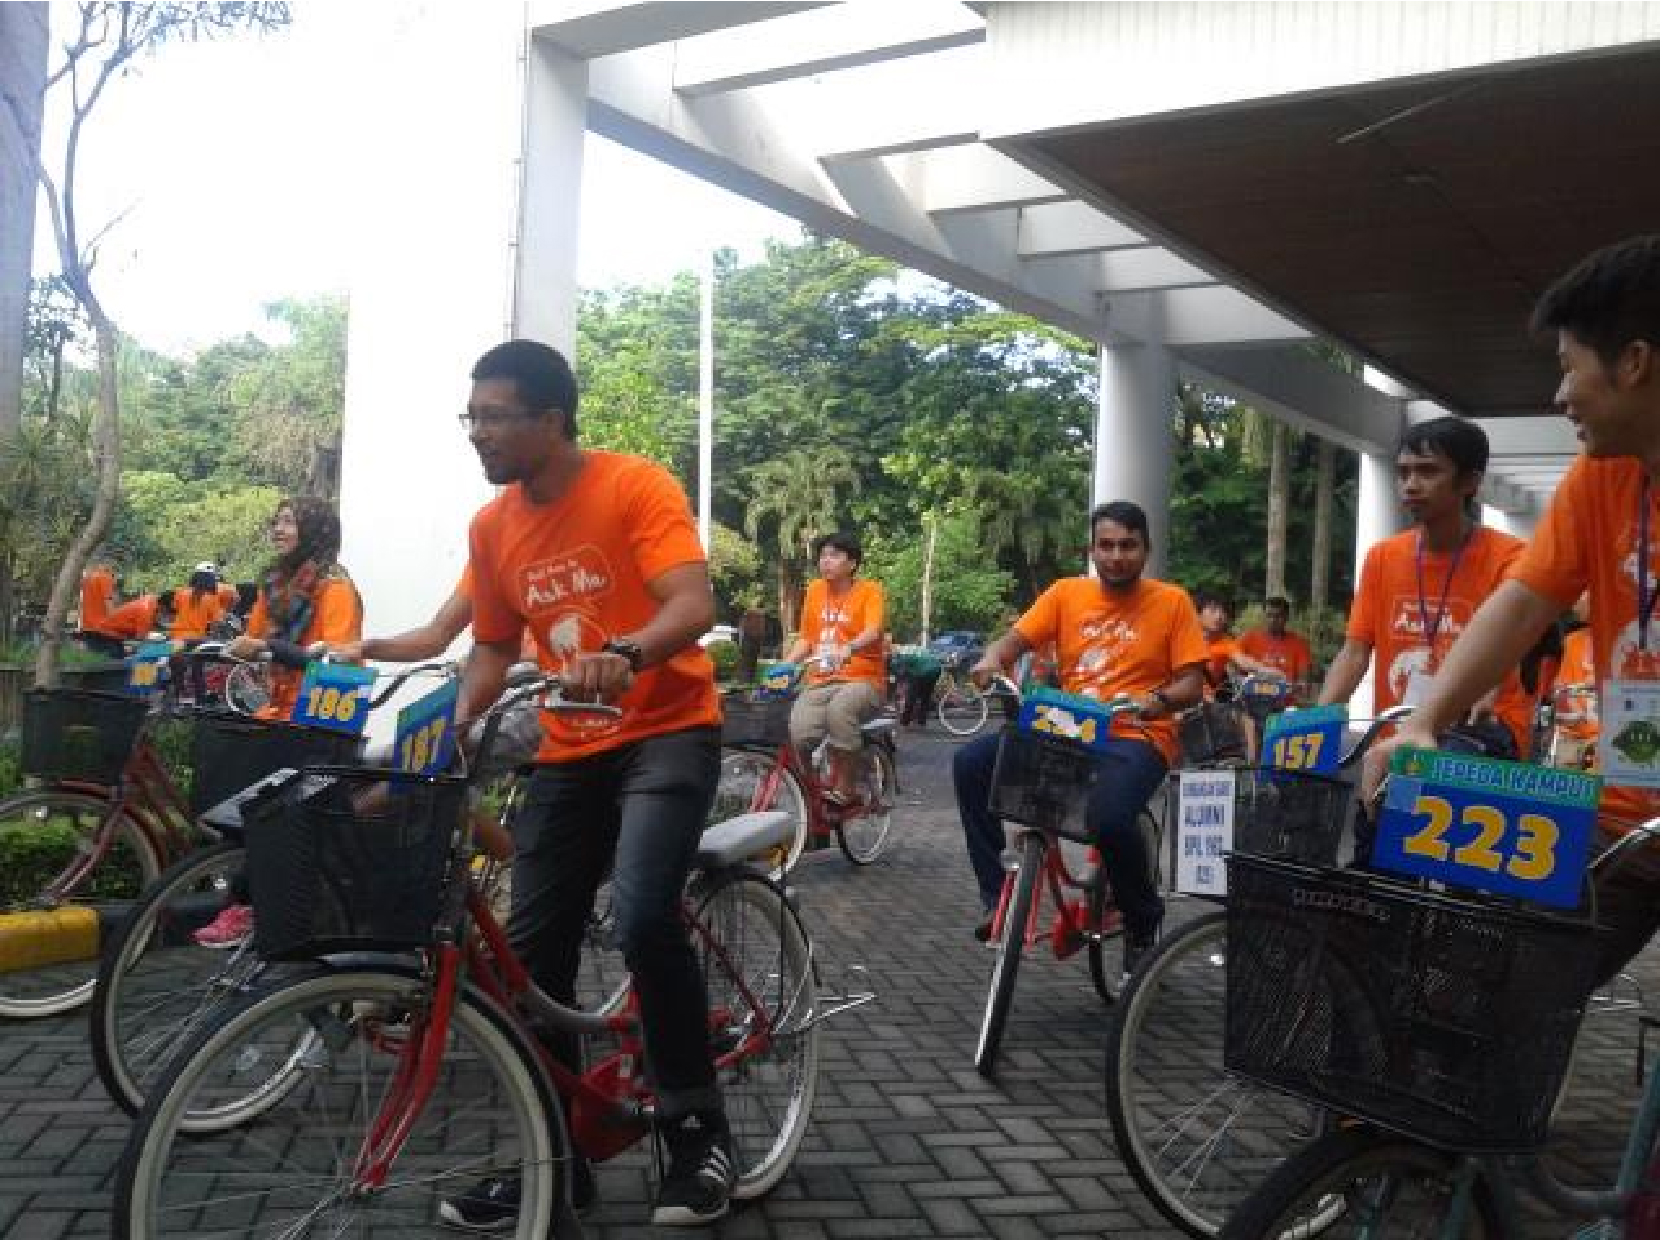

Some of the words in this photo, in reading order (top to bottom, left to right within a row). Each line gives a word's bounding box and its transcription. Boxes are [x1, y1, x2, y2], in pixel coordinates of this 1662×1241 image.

[305, 685, 359, 722] 186
[401, 716, 447, 773] 187
[1272, 732, 1325, 770] 157
[1403, 795, 1560, 880] 223
